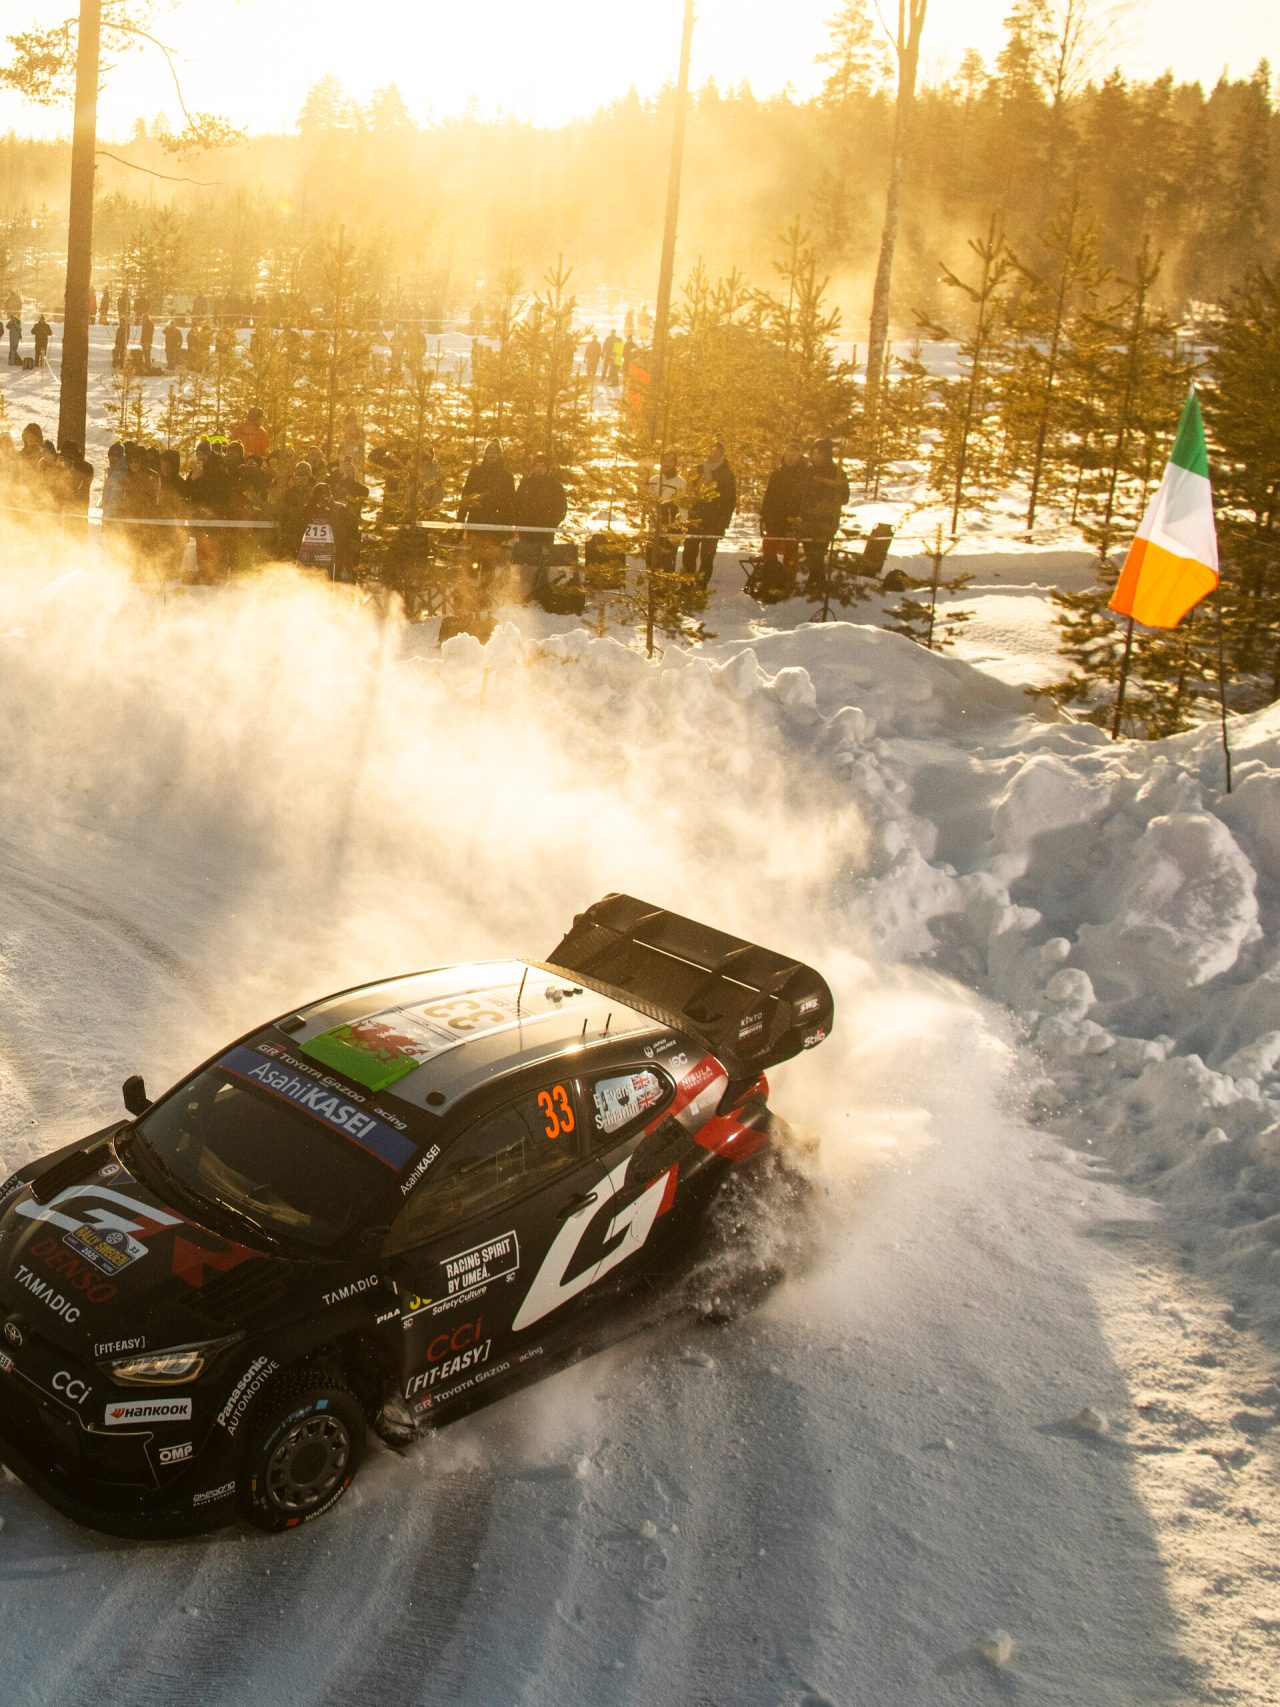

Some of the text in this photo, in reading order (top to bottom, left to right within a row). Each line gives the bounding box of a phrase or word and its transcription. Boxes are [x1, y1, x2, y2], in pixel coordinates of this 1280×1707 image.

[305, 526, 327, 537] 215
[424, 1000, 505, 1031] 33
[740, 1012, 763, 1027] KINTO
[652, 1038, 667, 1049] JAPAN
[656, 1040, 677, 1054] AIRLINES
[279, 1053, 322, 1080] TOYOTA
[319, 1077, 367, 1104] GAZOO
[367, 1103, 407, 1131] acing
[681, 1066, 712, 1087] NISULA
[248, 1062, 377, 1139] AsahiKASEI
[537, 1084, 576, 1139] 33
[400, 1144, 441, 1195] AsahiKASEI
[75, 1225, 101, 1249] RALLY
[95, 1239, 132, 1266] SWEDEN
[80, 1247, 99, 1261] 2025
[445, 1238, 511, 1279] RACING SPIRIT
[30, 1235, 118, 1304] DENSO
[14, 1264, 81, 1324] TAMADIC
[322, 1274, 379, 1305] TAMADIC
[432, 1286, 487, 1316] SafetyCulture
[448, 1280, 460, 1294] BY
[376, 1308, 401, 1325] PIAA
[217, 1355, 268, 1427] Panasonic
[227, 1359, 280, 1436] AUTOMOTIVE
[434, 1380, 476, 1403] TOYOTA
[475, 1361, 511, 1383] GAZOO
[159, 1445, 193, 1462] OMP
